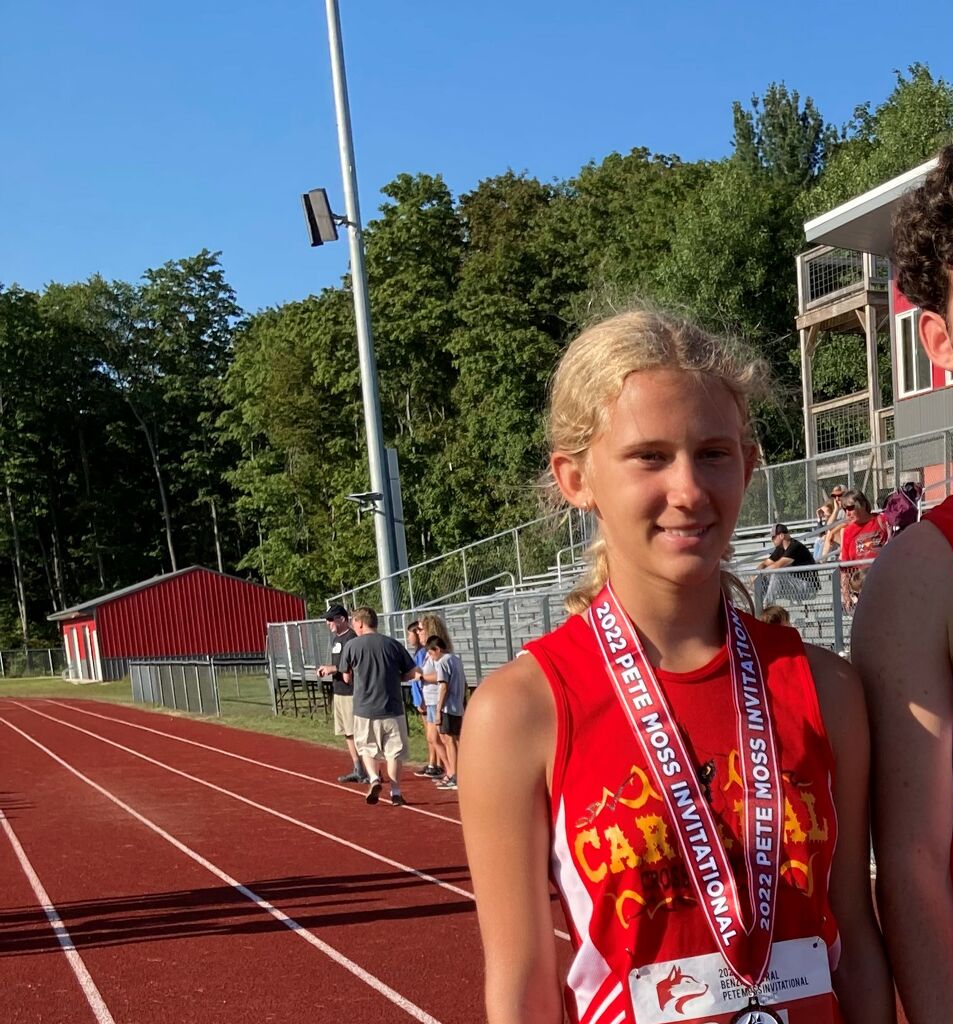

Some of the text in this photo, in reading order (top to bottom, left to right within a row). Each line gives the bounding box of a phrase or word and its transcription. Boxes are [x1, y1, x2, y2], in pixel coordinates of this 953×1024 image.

[595, 601, 739, 947] 2022 PETE MOSS INVITATIONAL
[729, 610, 774, 932] 2022 PETE MOSS INVITATION
[721, 989, 740, 1001] PETE
[761, 976, 809, 994] INVITATIONAL
